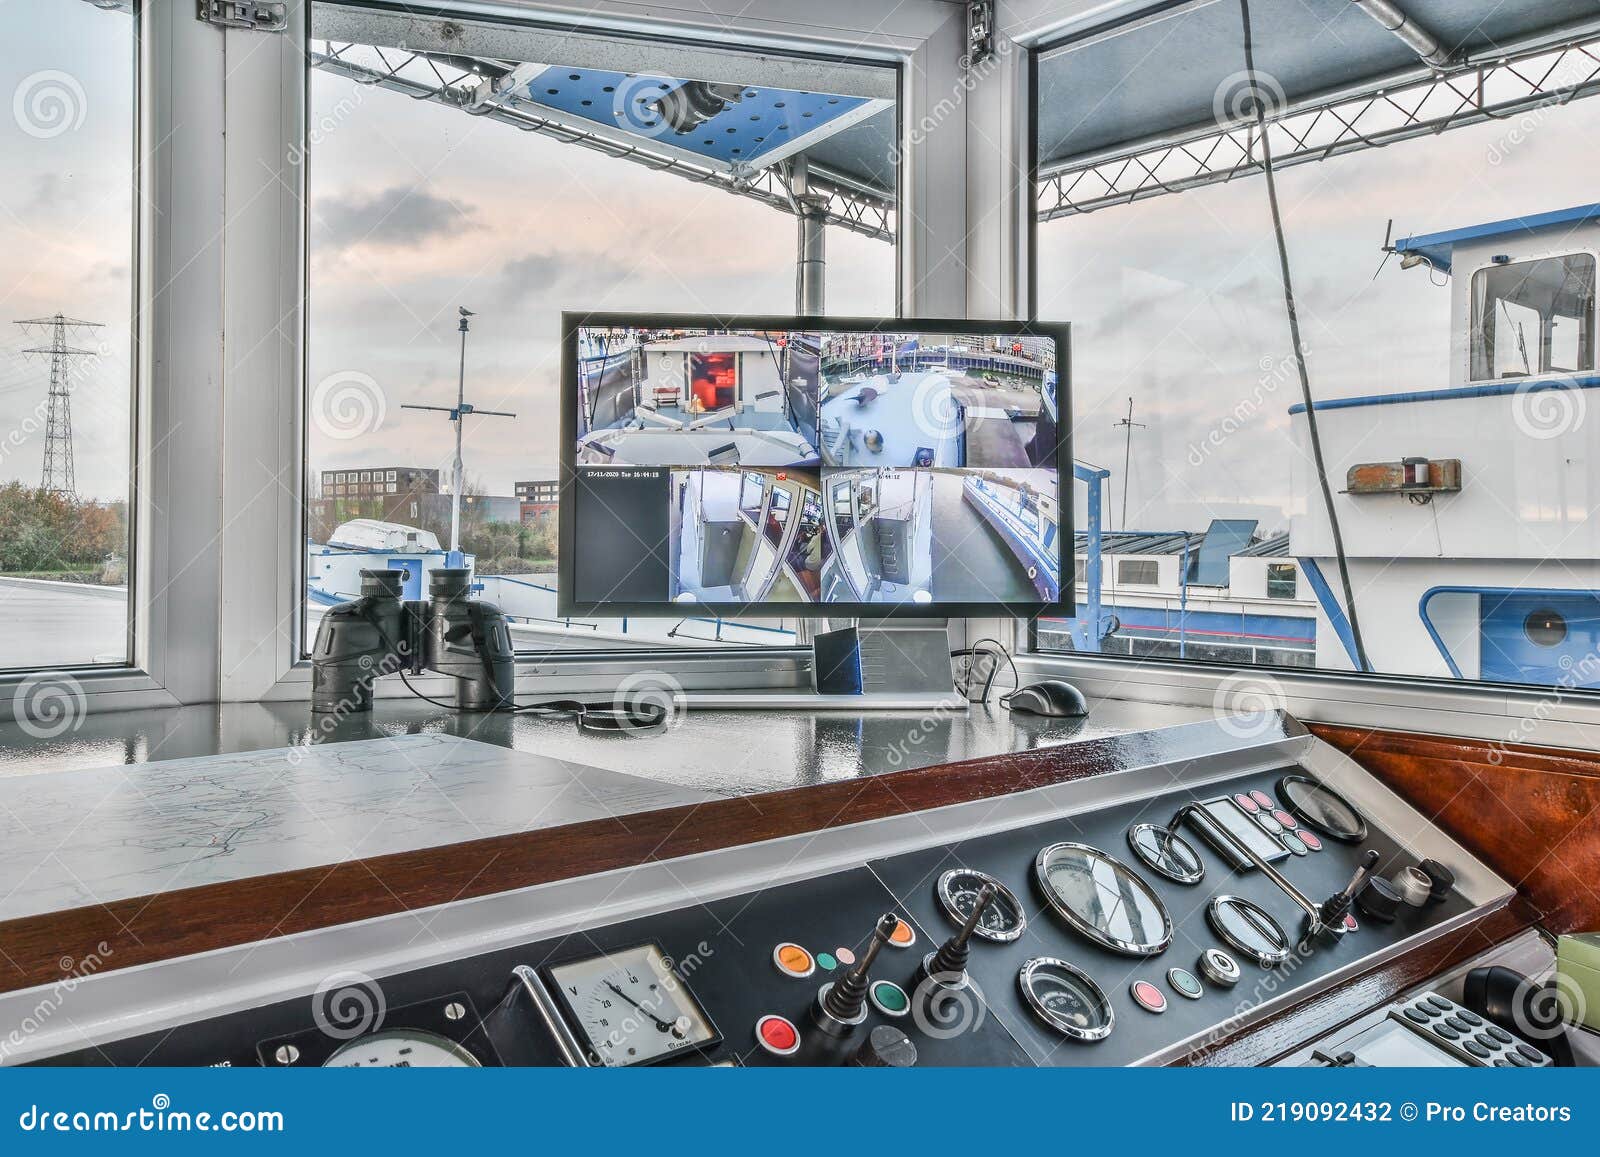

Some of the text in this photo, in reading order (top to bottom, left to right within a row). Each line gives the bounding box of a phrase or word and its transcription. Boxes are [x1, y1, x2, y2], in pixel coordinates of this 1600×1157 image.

[569, 986, 578, 996] V
[601, 999, 612, 1009] 20
[600, 1018, 609, 1027] 10
[606, 1041, 613, 1049] 0
